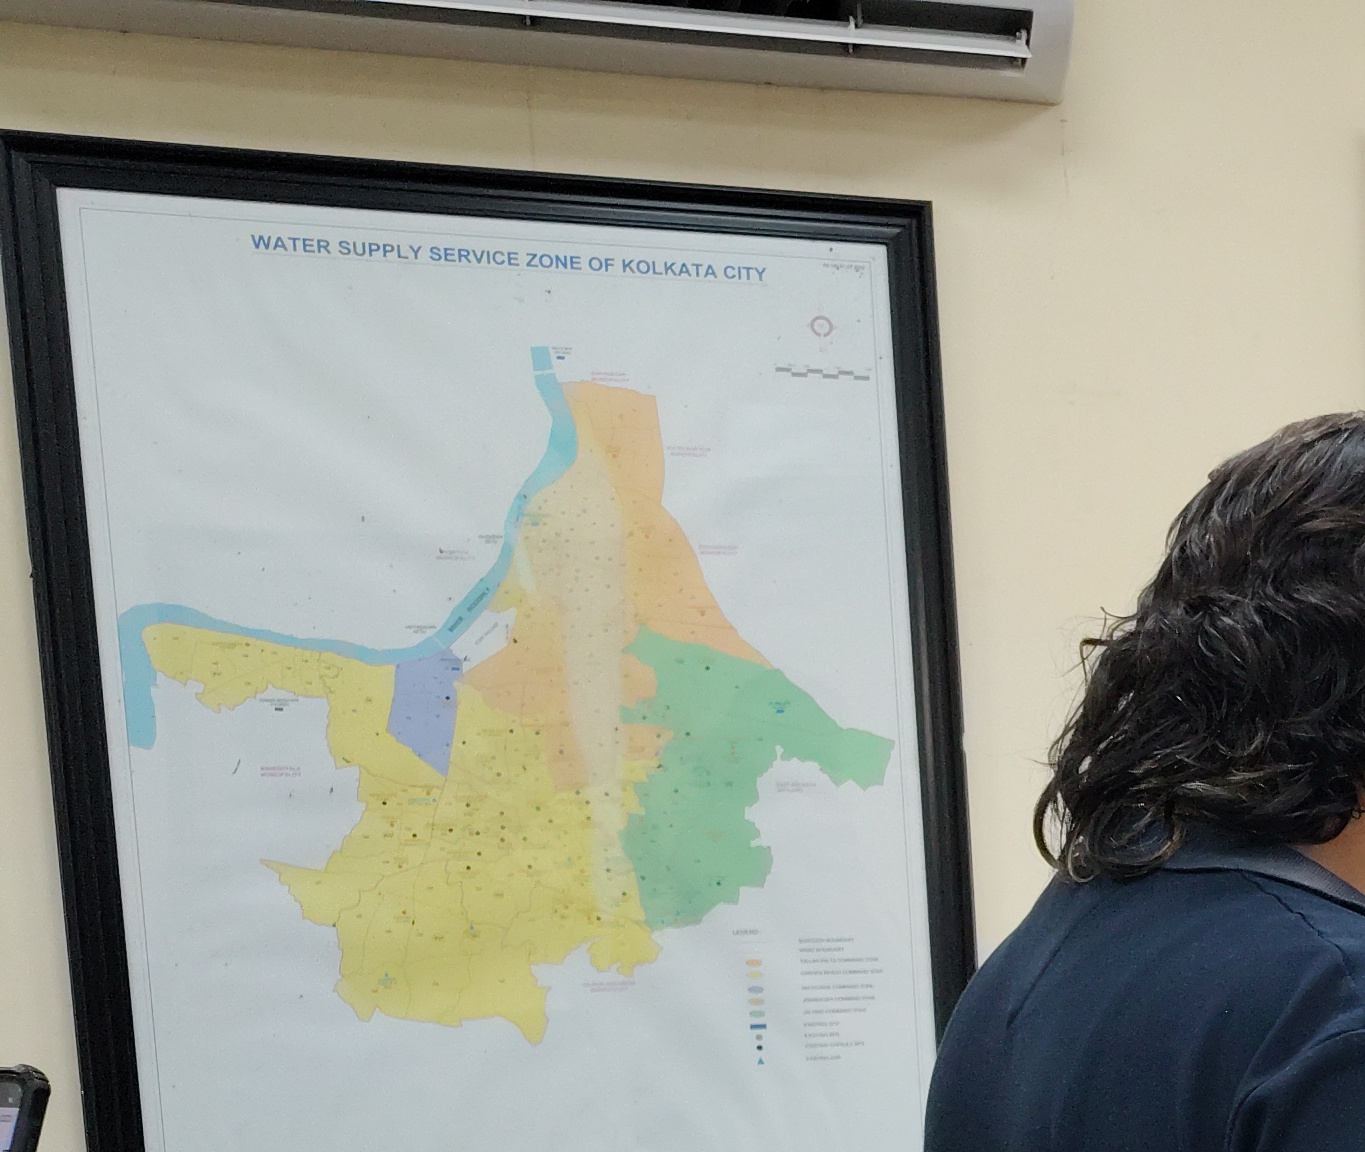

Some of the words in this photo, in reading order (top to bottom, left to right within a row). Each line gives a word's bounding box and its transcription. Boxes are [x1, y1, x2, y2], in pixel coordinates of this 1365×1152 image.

[251, 234, 331, 255] WATER
[338, 240, 422, 261] SUPPLY
[429, 246, 520, 267] SERVICE
[526, 252, 582, 271] ZONE
[588, 256, 615, 273] OF
[621, 258, 718, 279] KOLKATA
[723, 265, 767, 282] CITY
